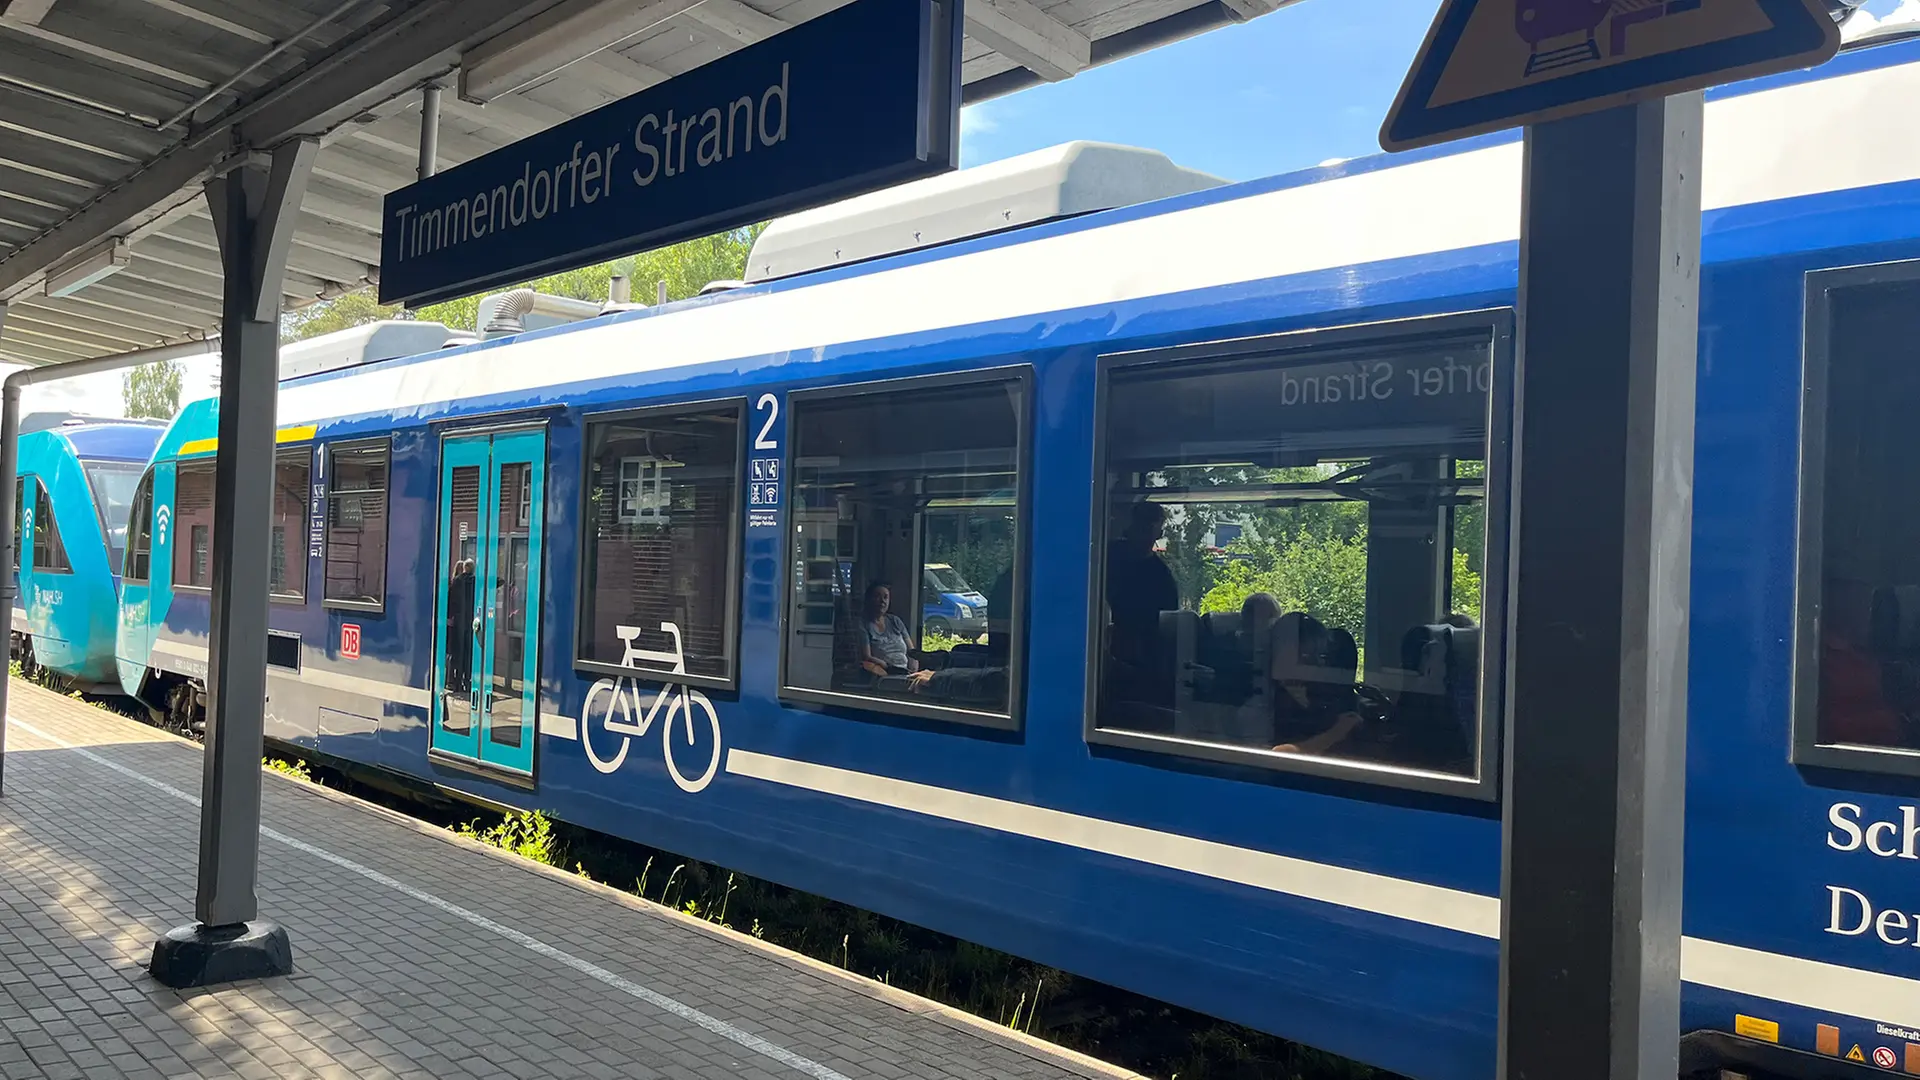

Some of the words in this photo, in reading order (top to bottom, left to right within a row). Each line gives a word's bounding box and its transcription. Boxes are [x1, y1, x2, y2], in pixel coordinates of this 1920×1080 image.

[396, 139, 620, 263] Timmendorfer
[632, 61, 790, 187] Strand
[755, 393, 779, 450] 2
[317, 442, 325, 479] 1
[343, 630, 358, 654] DB
[1826, 802, 1920, 860] Sch
